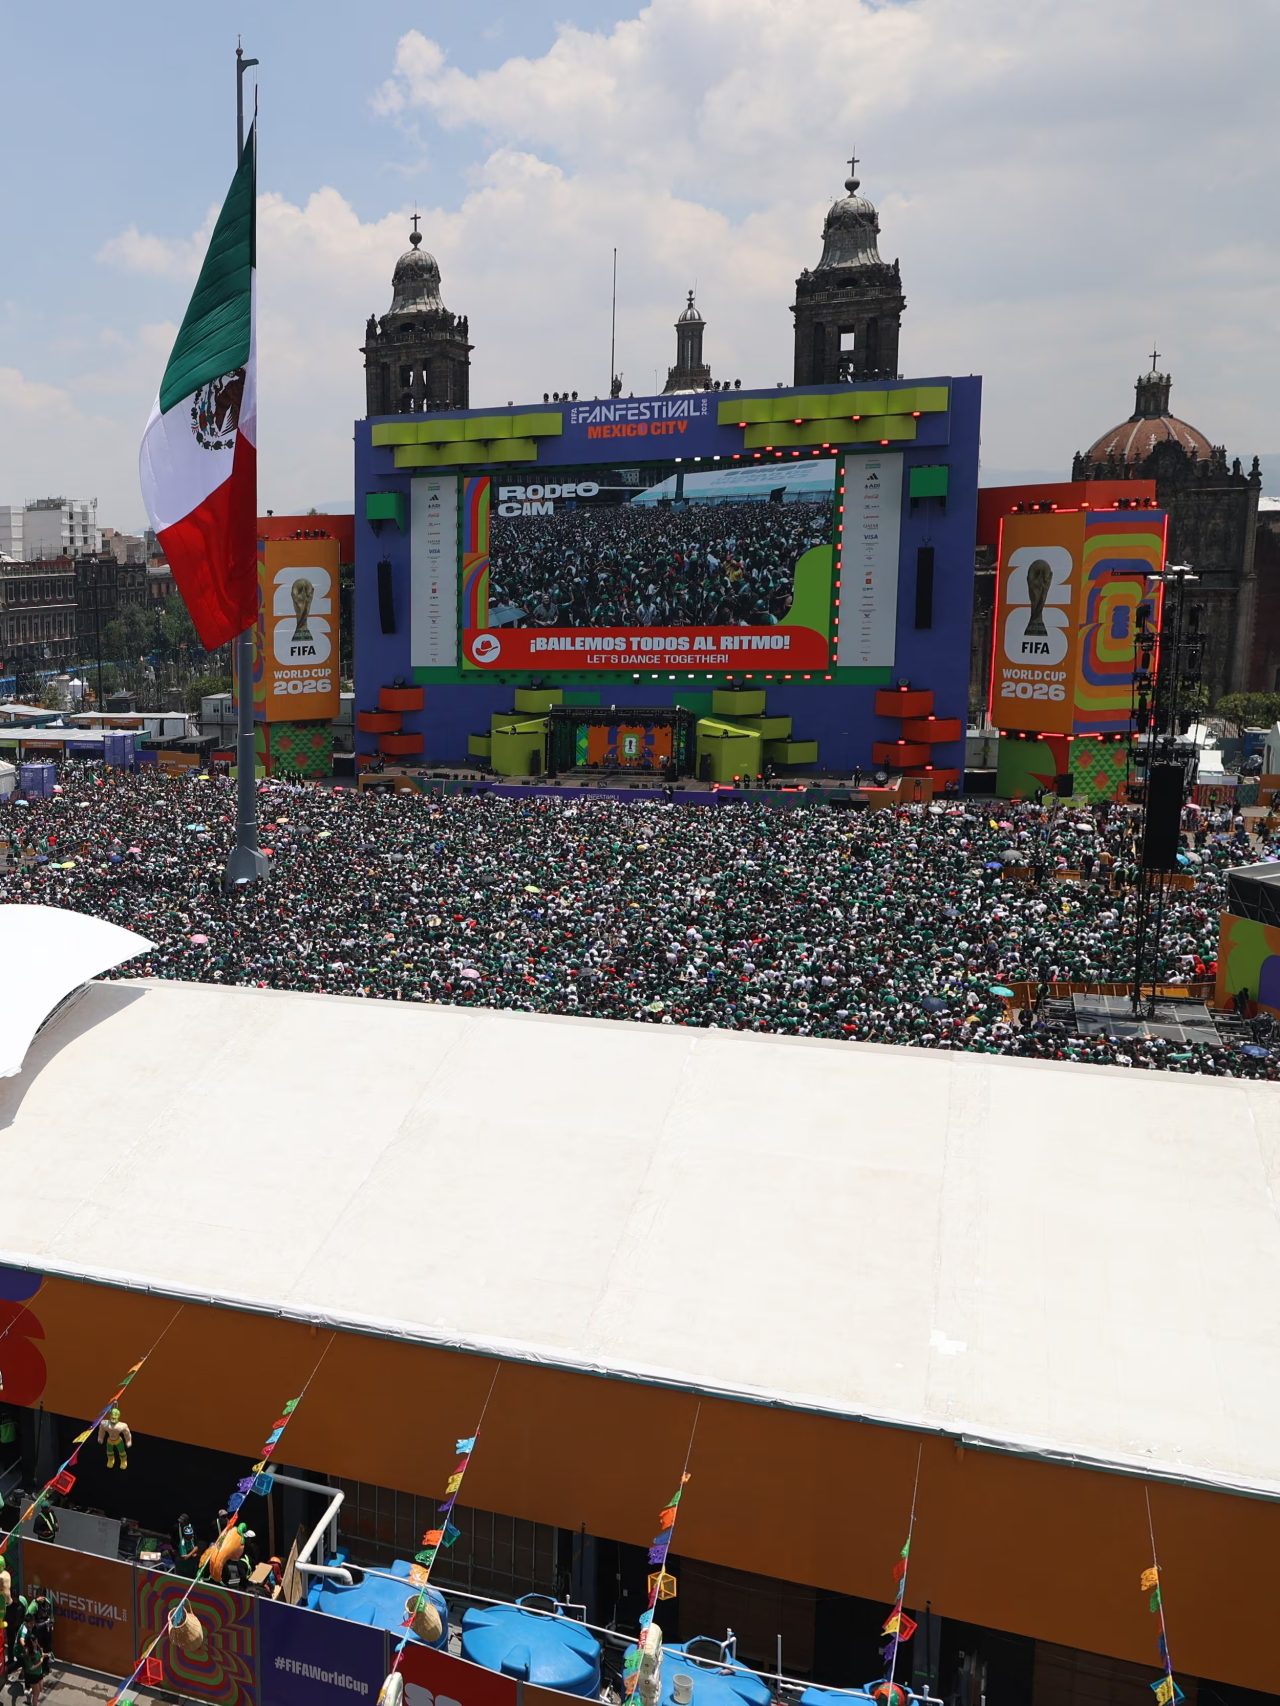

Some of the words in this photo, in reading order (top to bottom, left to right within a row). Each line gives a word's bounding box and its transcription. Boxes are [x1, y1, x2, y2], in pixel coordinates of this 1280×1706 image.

[570, 407, 578, 424] FIFA
[587, 422, 649, 440] MEXICO
[650, 420, 688, 436] CITY
[498, 481, 600, 501] RODEO
[497, 501, 554, 517] CAM
[290, 646, 317, 657] FIFA
[530, 637, 627, 653] ¡BAILEMOS
[629, 637, 690, 651] TODOS
[693, 637, 717, 651] AL
[719, 635, 791, 650] RITMO!
[1021, 641, 1050, 655] FIFA
[620, 654, 661, 664] DANCE
[663, 653, 729, 664] TOGETHER!
[274, 668, 312, 679] WORLD
[312, 667, 332, 678] CUP
[1002, 668, 1042, 681] WORLD
[1042, 670, 1067, 682] CUP
[273, 679, 332, 695] 2026
[1001, 681, 1066, 701] 2026
[275, 1656, 369, 1696] #FIFAWorldCup
